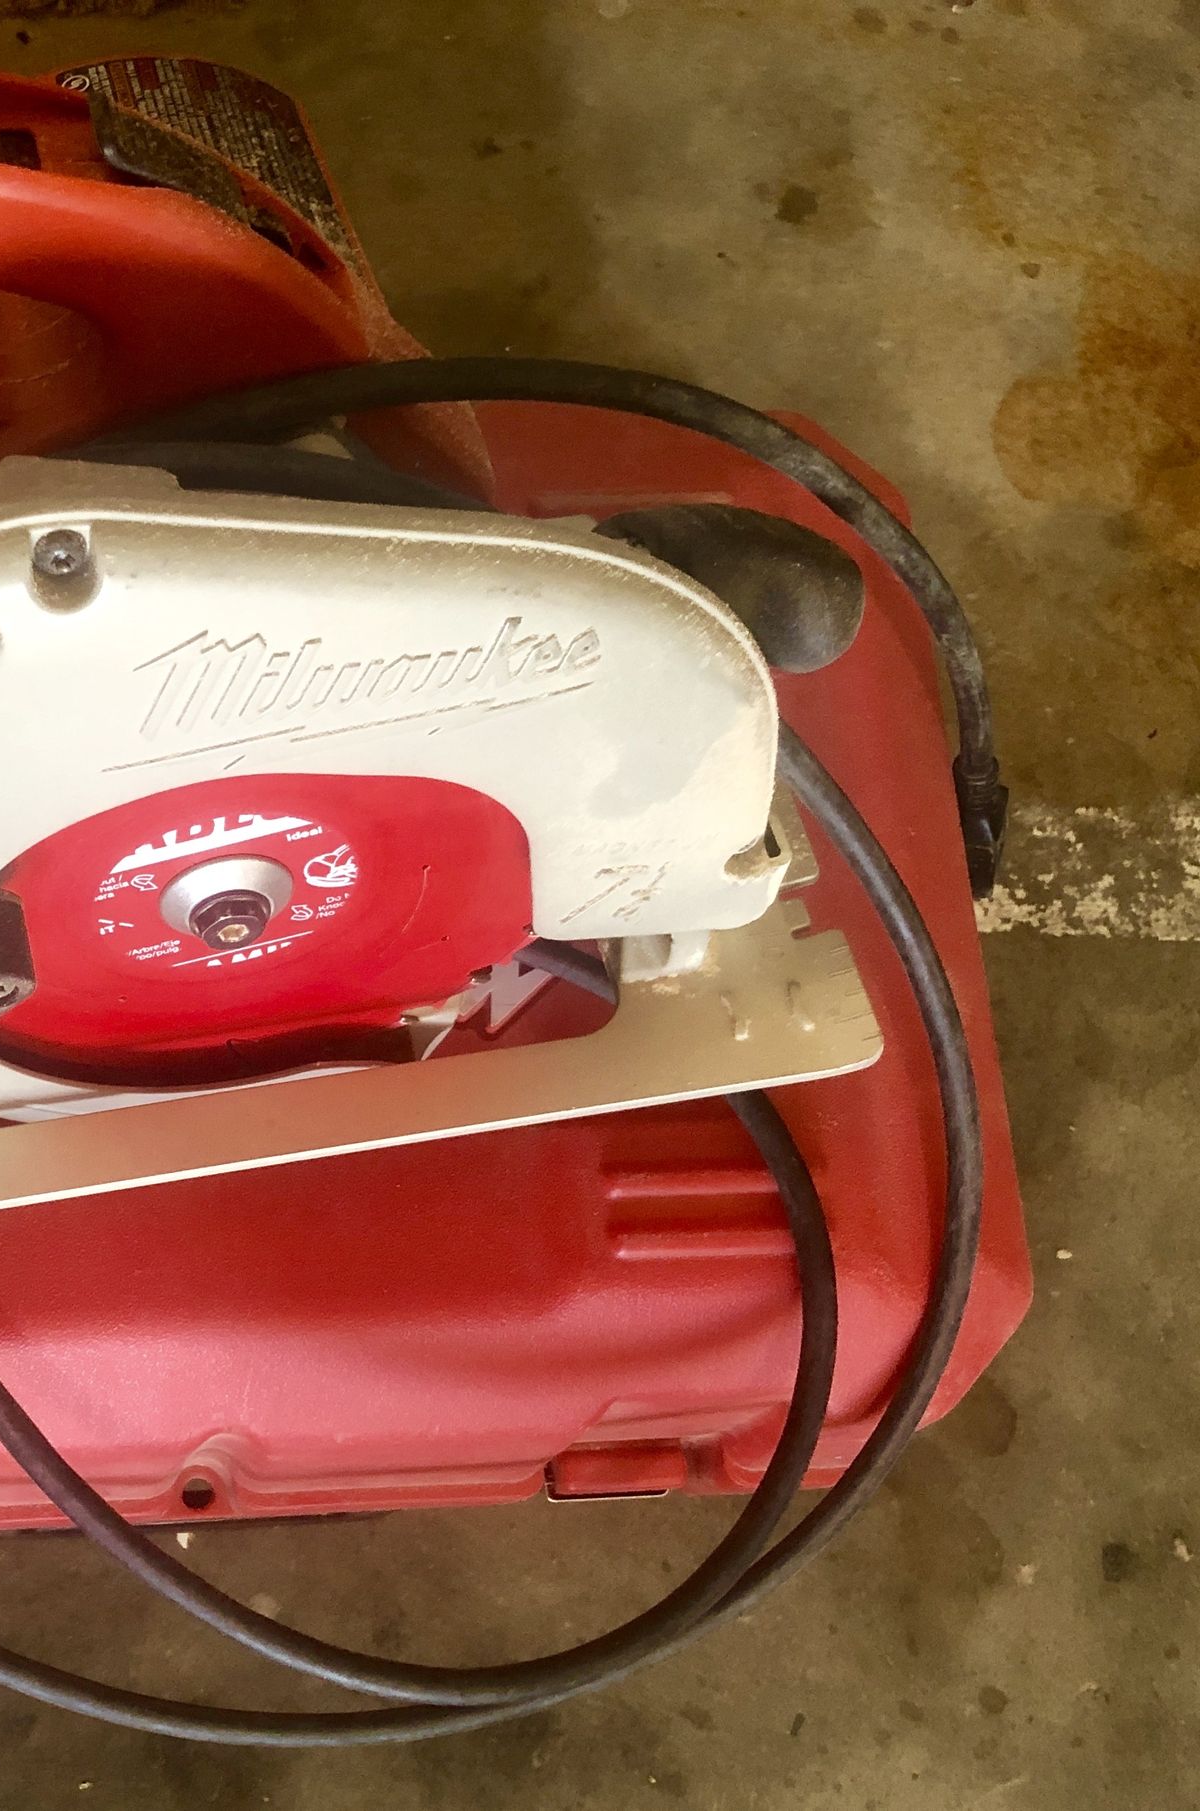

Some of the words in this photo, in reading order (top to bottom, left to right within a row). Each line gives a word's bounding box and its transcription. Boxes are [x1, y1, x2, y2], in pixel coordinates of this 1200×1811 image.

[133, 615, 602, 740] Milwaukee
[286, 825, 323, 842] Ideal
[99, 881, 130, 893] hacia
